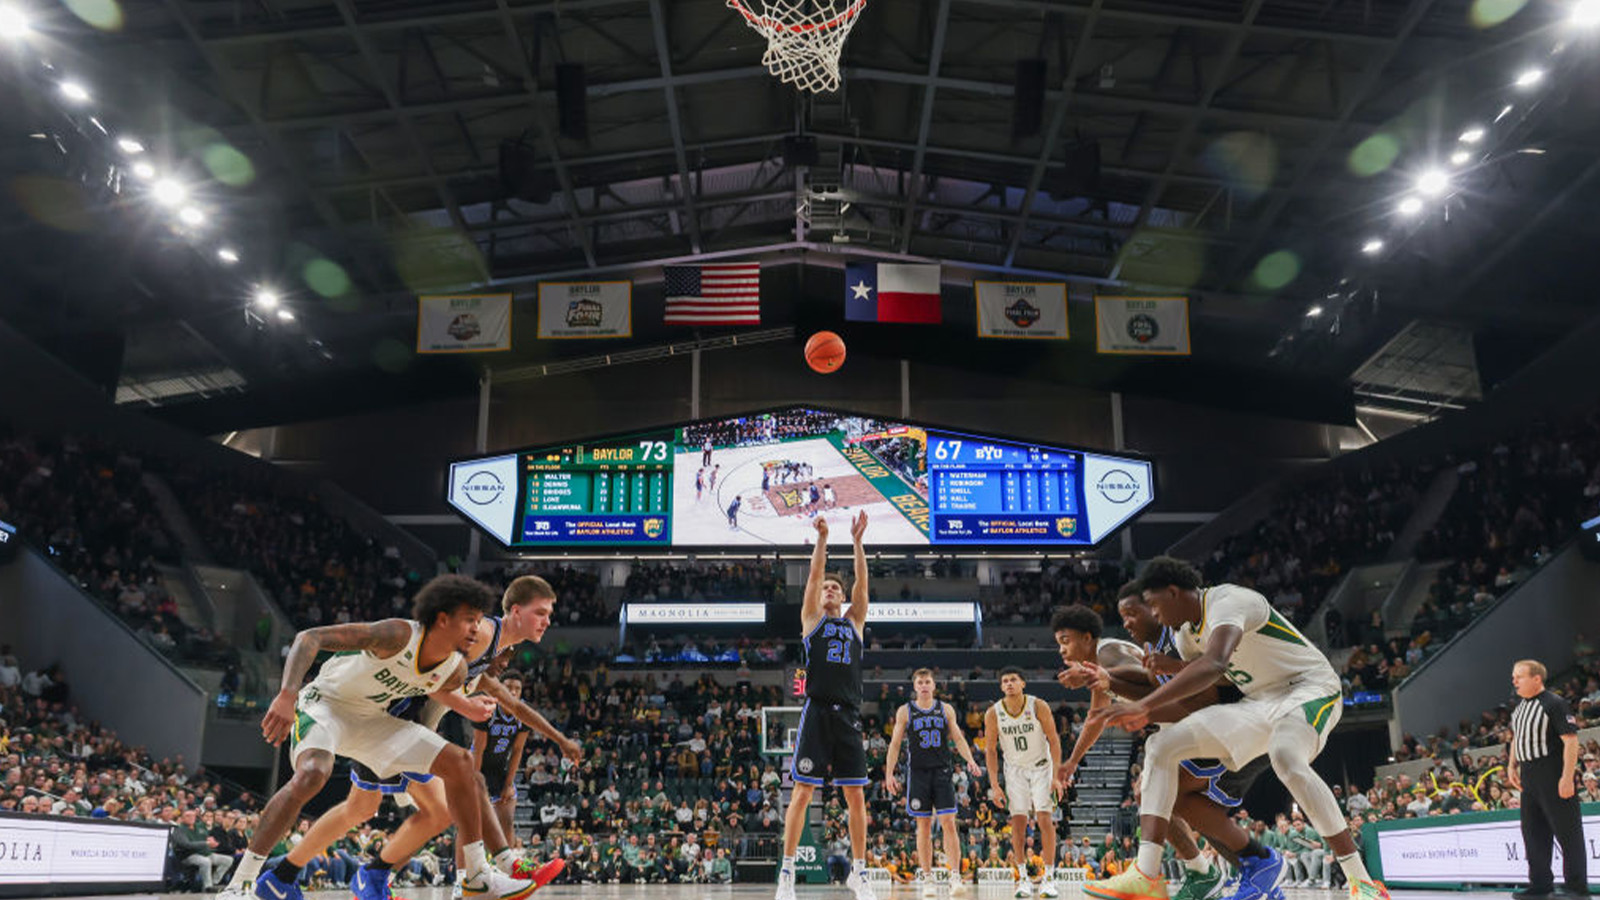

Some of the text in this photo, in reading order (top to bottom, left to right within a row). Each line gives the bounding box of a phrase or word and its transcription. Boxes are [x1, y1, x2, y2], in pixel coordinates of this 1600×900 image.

[593, 441, 668, 461] BAYLOR 73
[935, 440, 962, 460] 67
[975, 446, 1003, 460] BYU
[639, 609, 709, 617] MAGNOLIA
[868, 608, 918, 616] GNOLIA
[827, 640, 851, 664] 21
[912, 716, 944, 731] BYU
[1002, 723, 1034, 735] BAYLOR
[494, 738, 510, 754] 2
[919, 729, 941, 749] 30
[1013, 736, 1028, 752] 10
